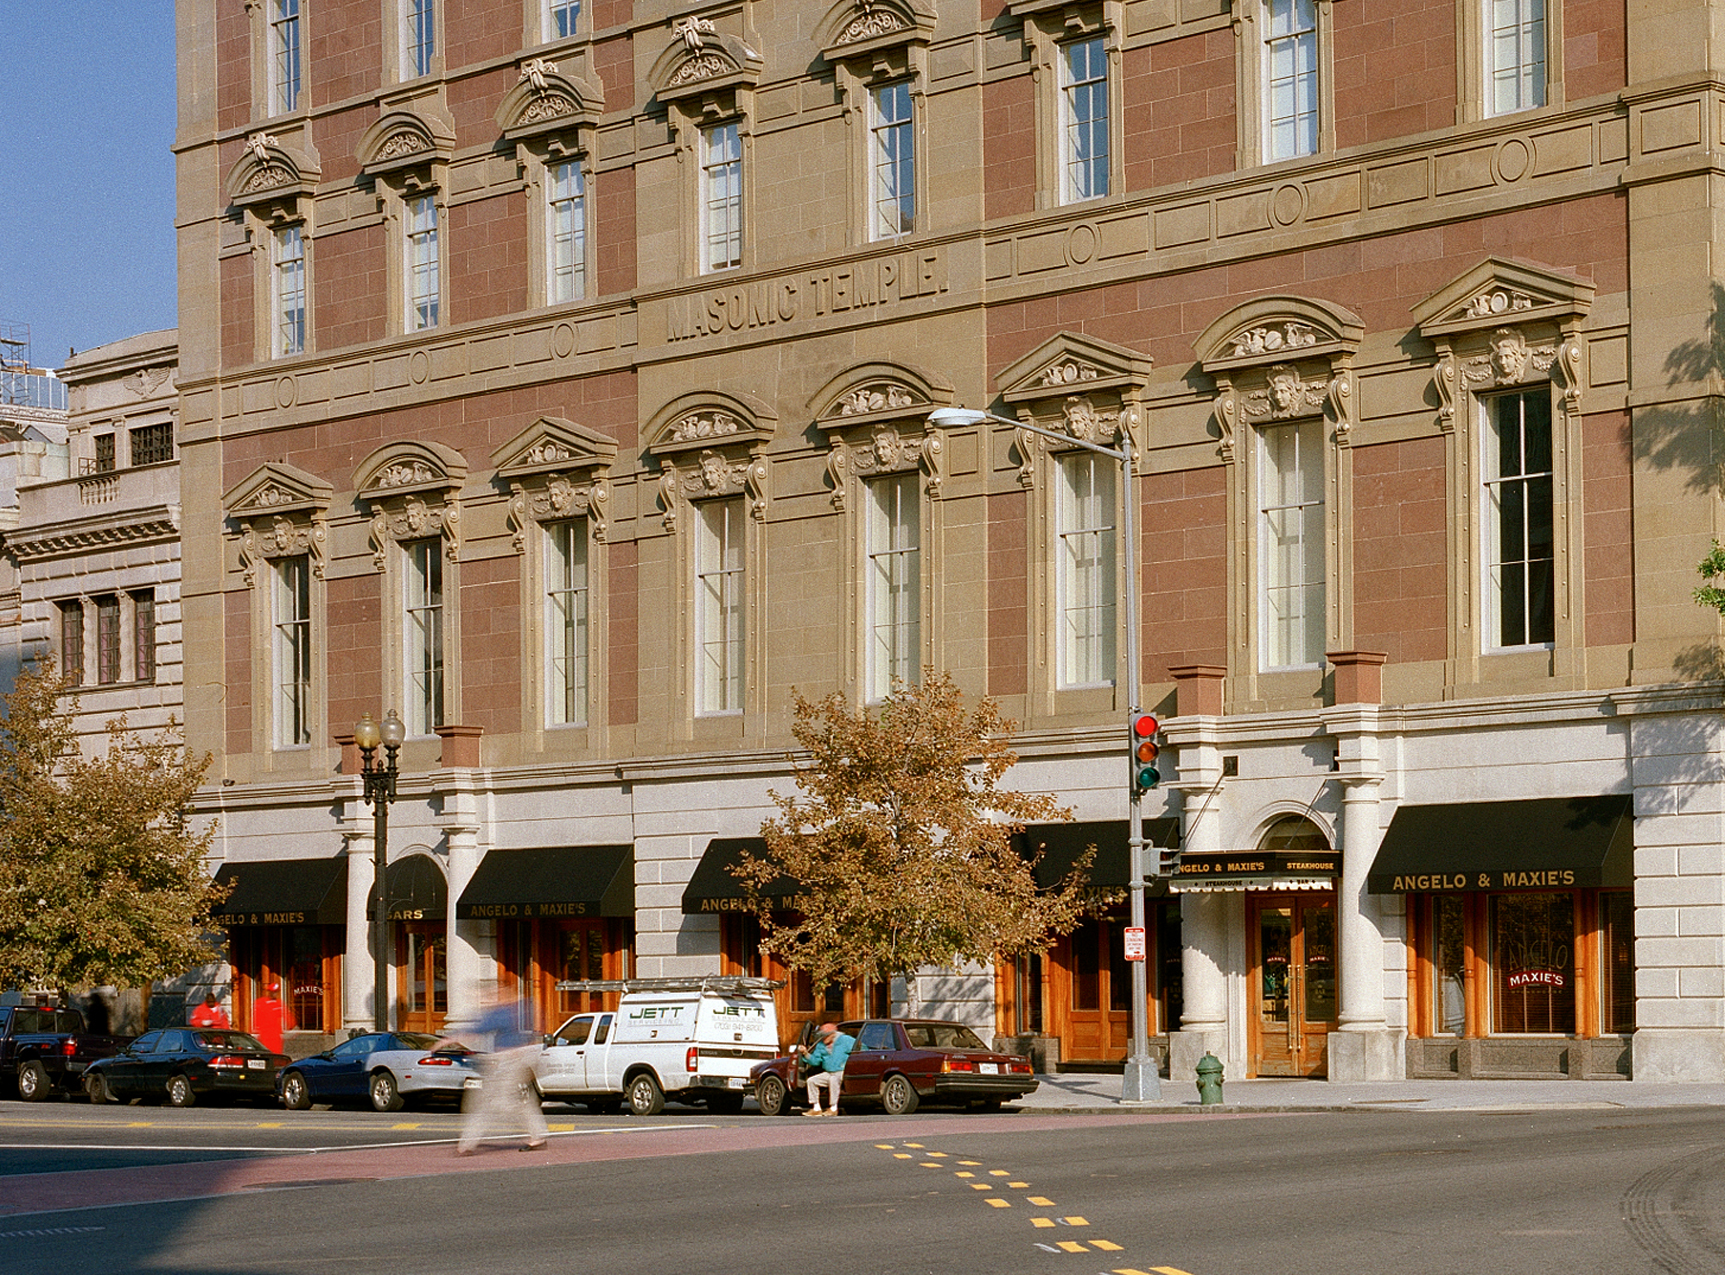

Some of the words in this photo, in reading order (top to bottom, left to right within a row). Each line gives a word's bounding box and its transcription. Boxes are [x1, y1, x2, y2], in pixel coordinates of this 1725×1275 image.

[667, 277, 798, 342] MASONIC
[1180, 863, 1210, 874] NGELO
[1214, 863, 1222, 872] &
[1227, 861, 1265, 872] MAXIE'S
[1286, 862, 1334, 870] STEAKHOUSE
[1393, 874, 1467, 890] ANGELO
[1477, 873, 1491, 888] &
[1503, 870, 1575, 887] MAXIE'S
[1077, 886, 1124, 902] AXIE'S
[470, 905, 518, 917] ANGELO
[524, 904, 532, 915] &
[539, 903, 586, 915] MAXIE'S
[701, 898, 757, 911] ANGELO
[213, 913, 246, 925] GELO
[250, 913, 258, 924] &
[264, 911, 305, 924] MAXIE'S
[387, 909, 424, 921] ARS
[1509, 939, 1568, 972] ANGELO
[1510, 972, 1564, 987] MAXIE'S
[293, 984, 324, 996] MAXIE'S
[629, 1006, 684, 1019] JETT
[713, 1006, 765, 1017] JETT
